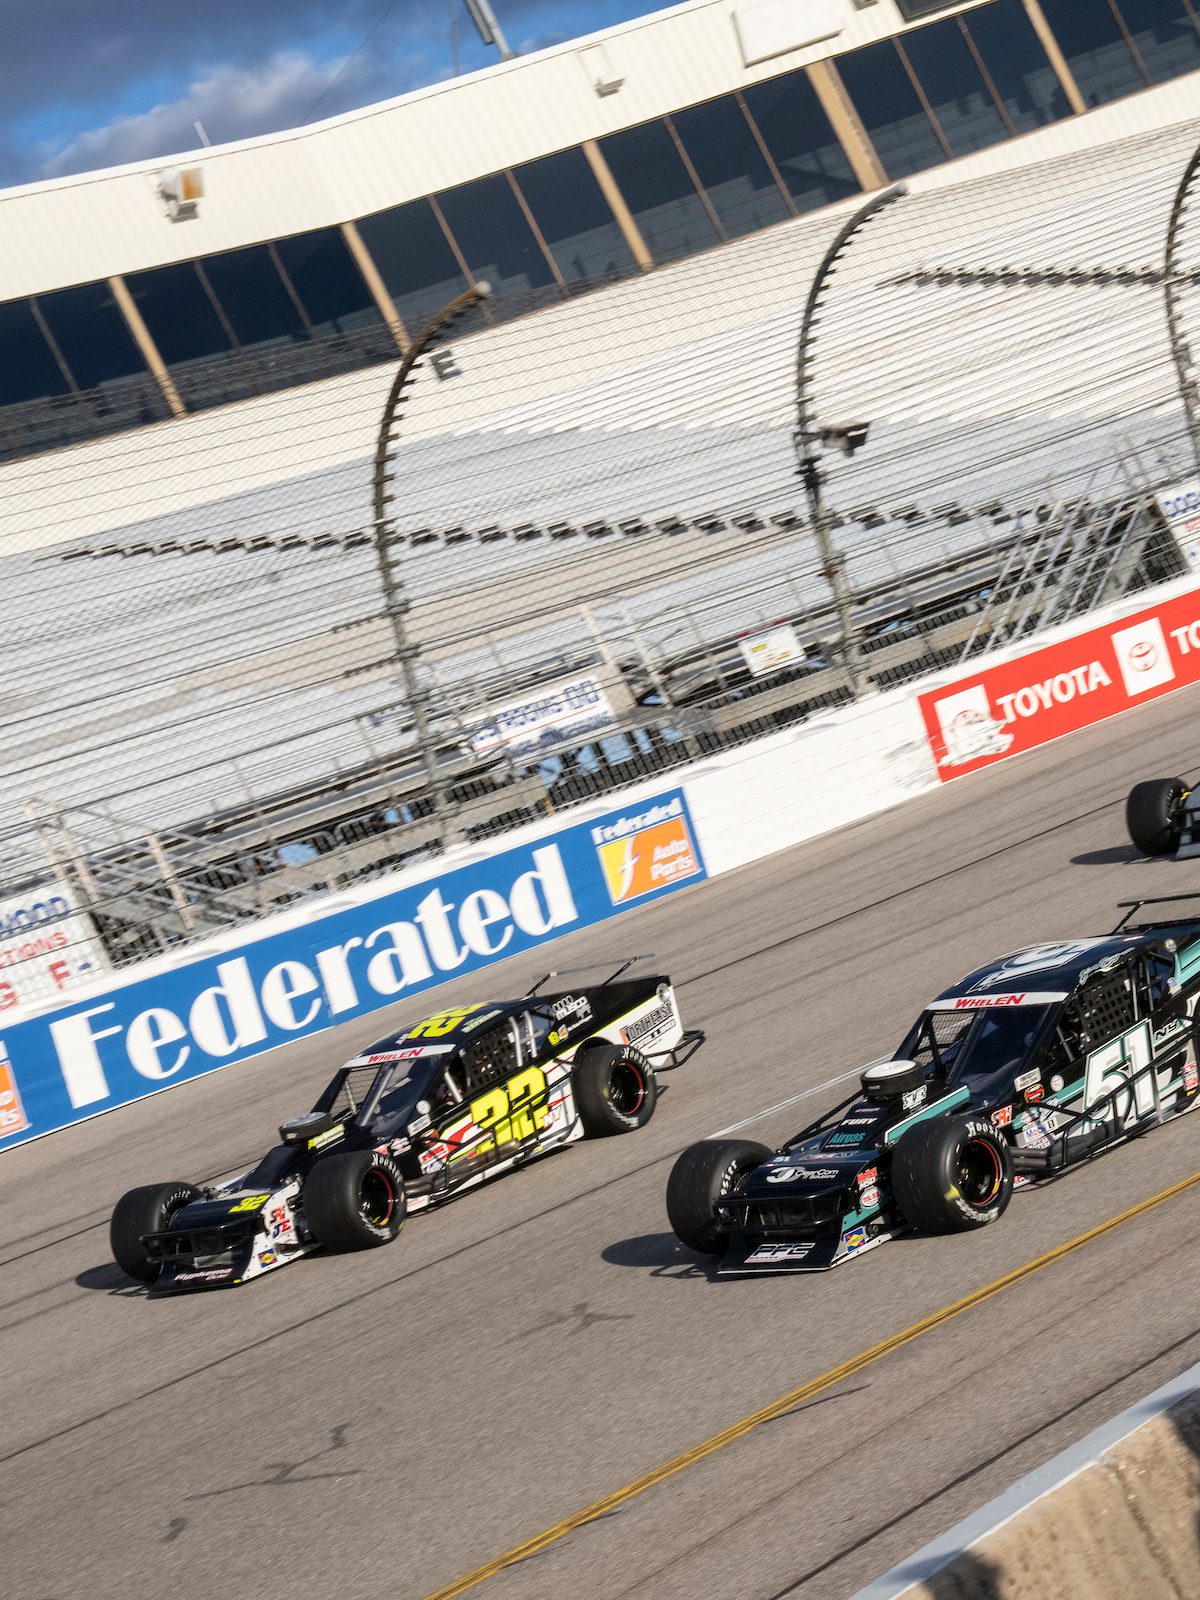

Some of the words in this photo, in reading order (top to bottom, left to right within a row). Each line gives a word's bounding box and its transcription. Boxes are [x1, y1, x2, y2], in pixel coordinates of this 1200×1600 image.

[429, 349, 462, 382] E
[995, 661, 1112, 724] TOYOTA
[592, 797, 682, 846] Federated
[48, 842, 578, 1110] Federated
[955, 993, 1026, 1009] WHELEN
[368, 1047, 425, 1064] WHELEN
[1082, 1018, 1157, 1130] 51
[841, 1117, 878, 1127] FURY
[828, 1131, 867, 1146] Airgas
[794, 1167, 839, 1179] ClearCom
